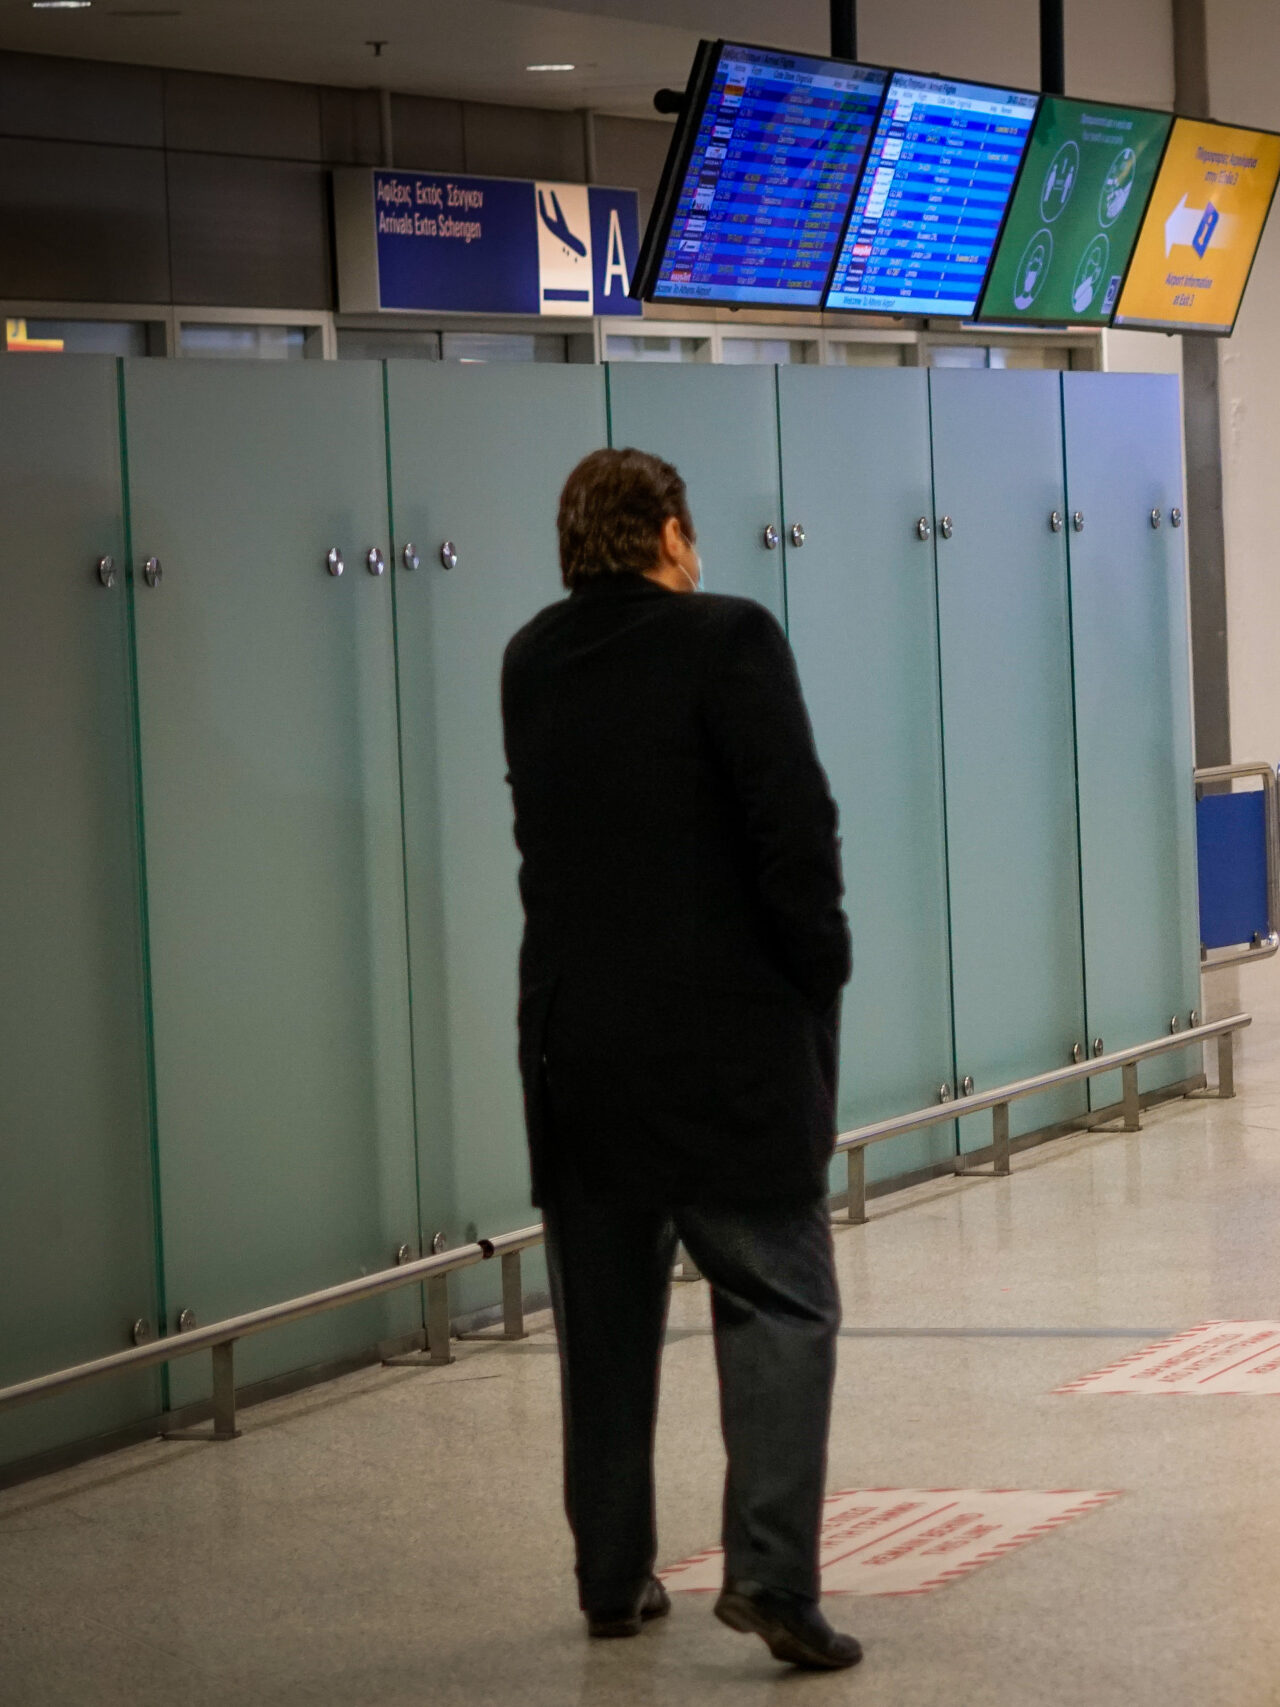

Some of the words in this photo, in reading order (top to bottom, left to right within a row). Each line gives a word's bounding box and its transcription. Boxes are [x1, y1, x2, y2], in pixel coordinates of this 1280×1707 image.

[377, 179, 412, 208] Αφίξεις
[416, 181, 443, 210] Εκτός
[379, 211, 414, 235] Arrivals
[414, 213, 438, 236] Extra
[438, 214, 481, 243] Schengen
[604, 208, 630, 297] A
